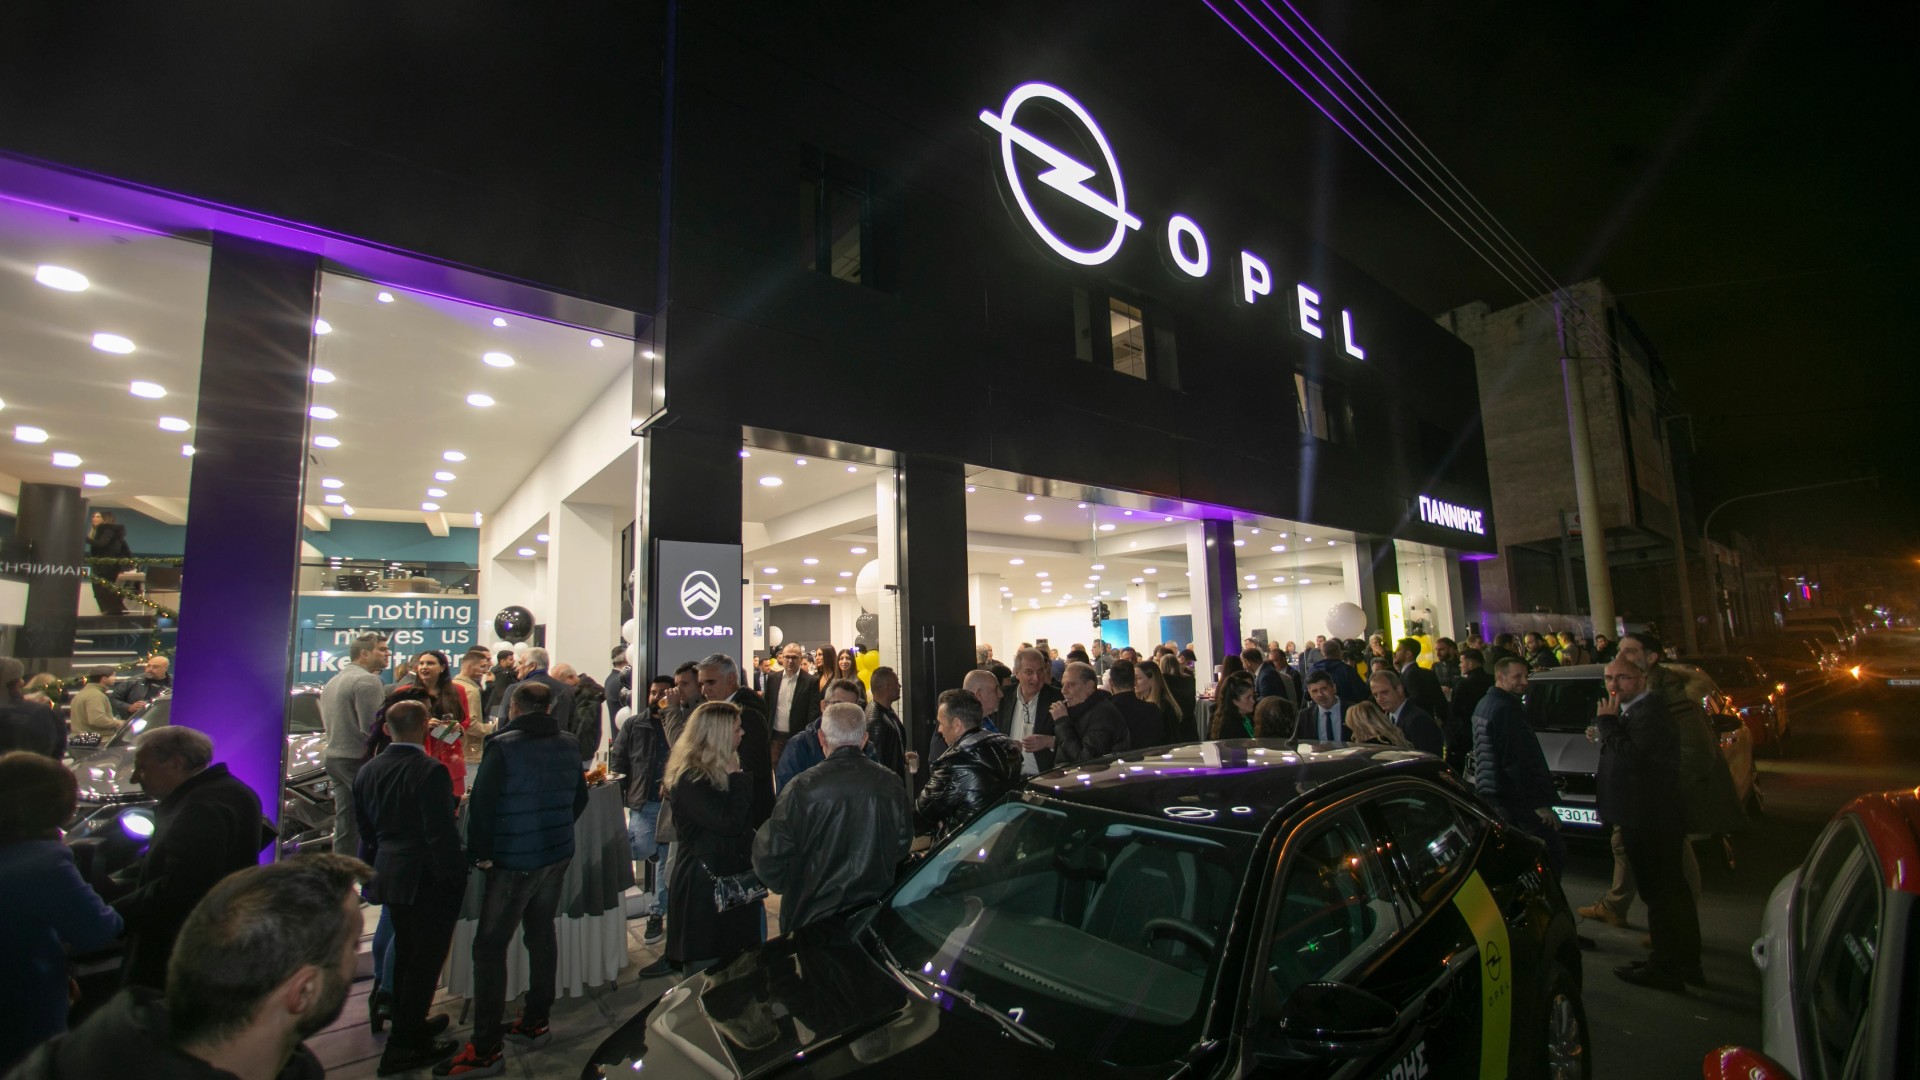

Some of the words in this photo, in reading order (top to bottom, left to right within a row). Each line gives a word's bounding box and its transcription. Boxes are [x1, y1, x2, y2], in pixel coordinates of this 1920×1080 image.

[1168, 214, 1366, 361] OPEL
[1419, 495, 1484, 534] ΓΙΑΝΝΙΡΗΣ
[367, 601, 471, 625] nothing
[441, 629, 469, 644] us
